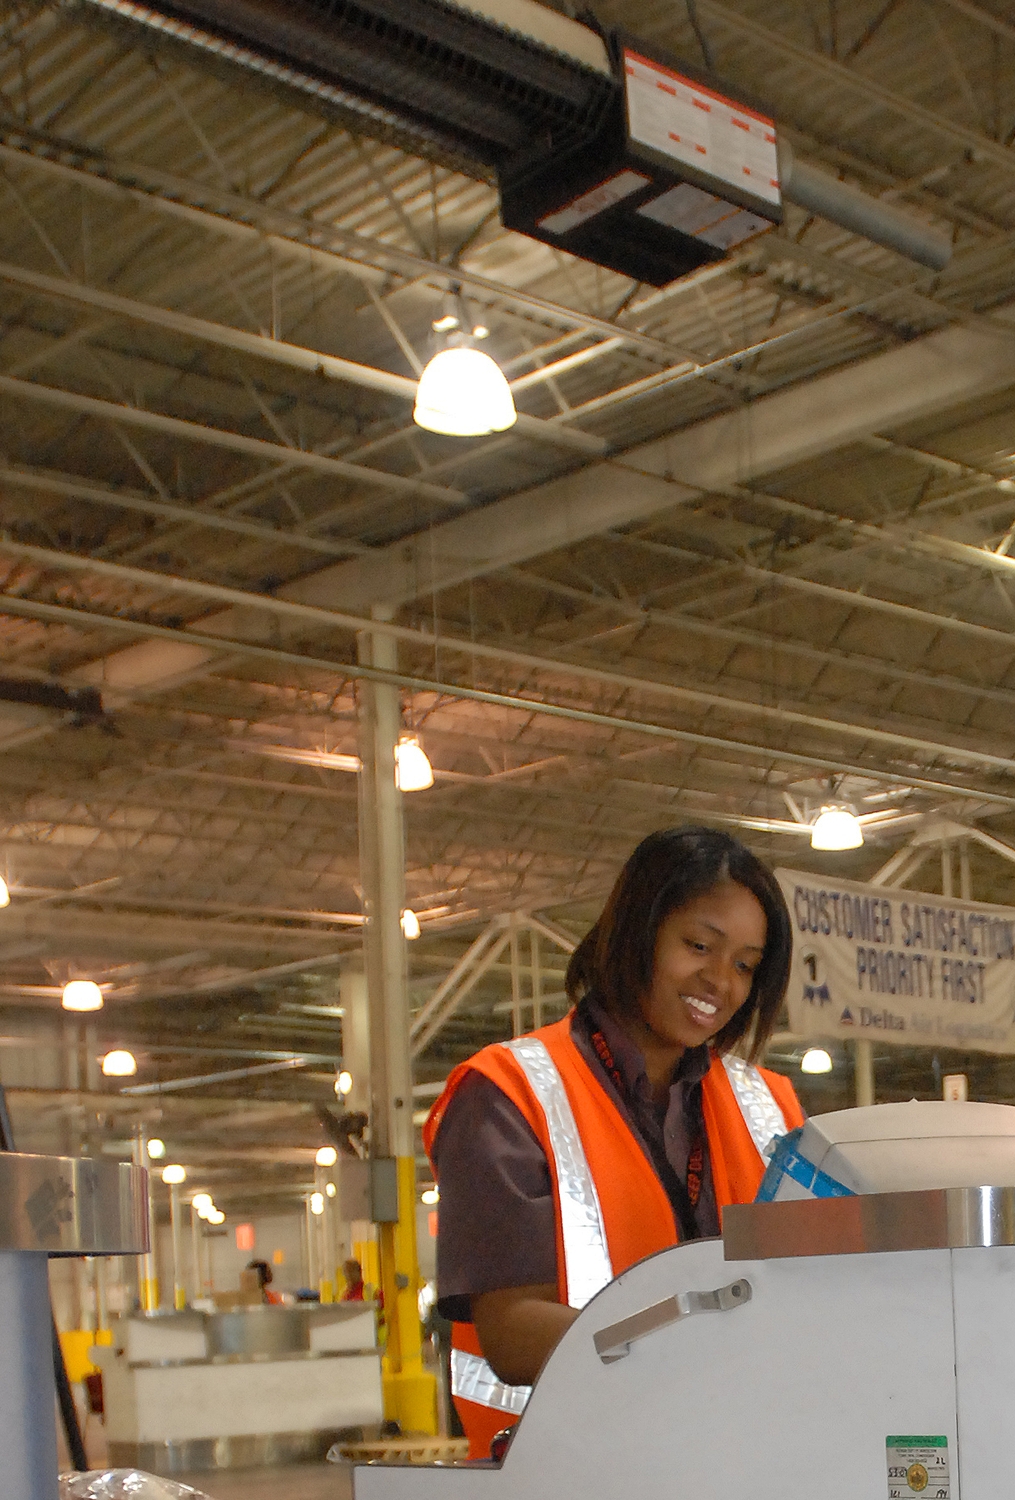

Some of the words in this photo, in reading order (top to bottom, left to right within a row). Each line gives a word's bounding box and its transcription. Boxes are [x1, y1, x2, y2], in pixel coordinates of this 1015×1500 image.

[794, 885, 892, 944] CUSTOMER
[901, 902, 1015, 961] SATISFACTION
[803, 951, 817, 982] 1
[857, 945, 934, 998] PRIORITY
[941, 957, 985, 1004] FIRST
[860, 1006, 905, 1031] Delta
